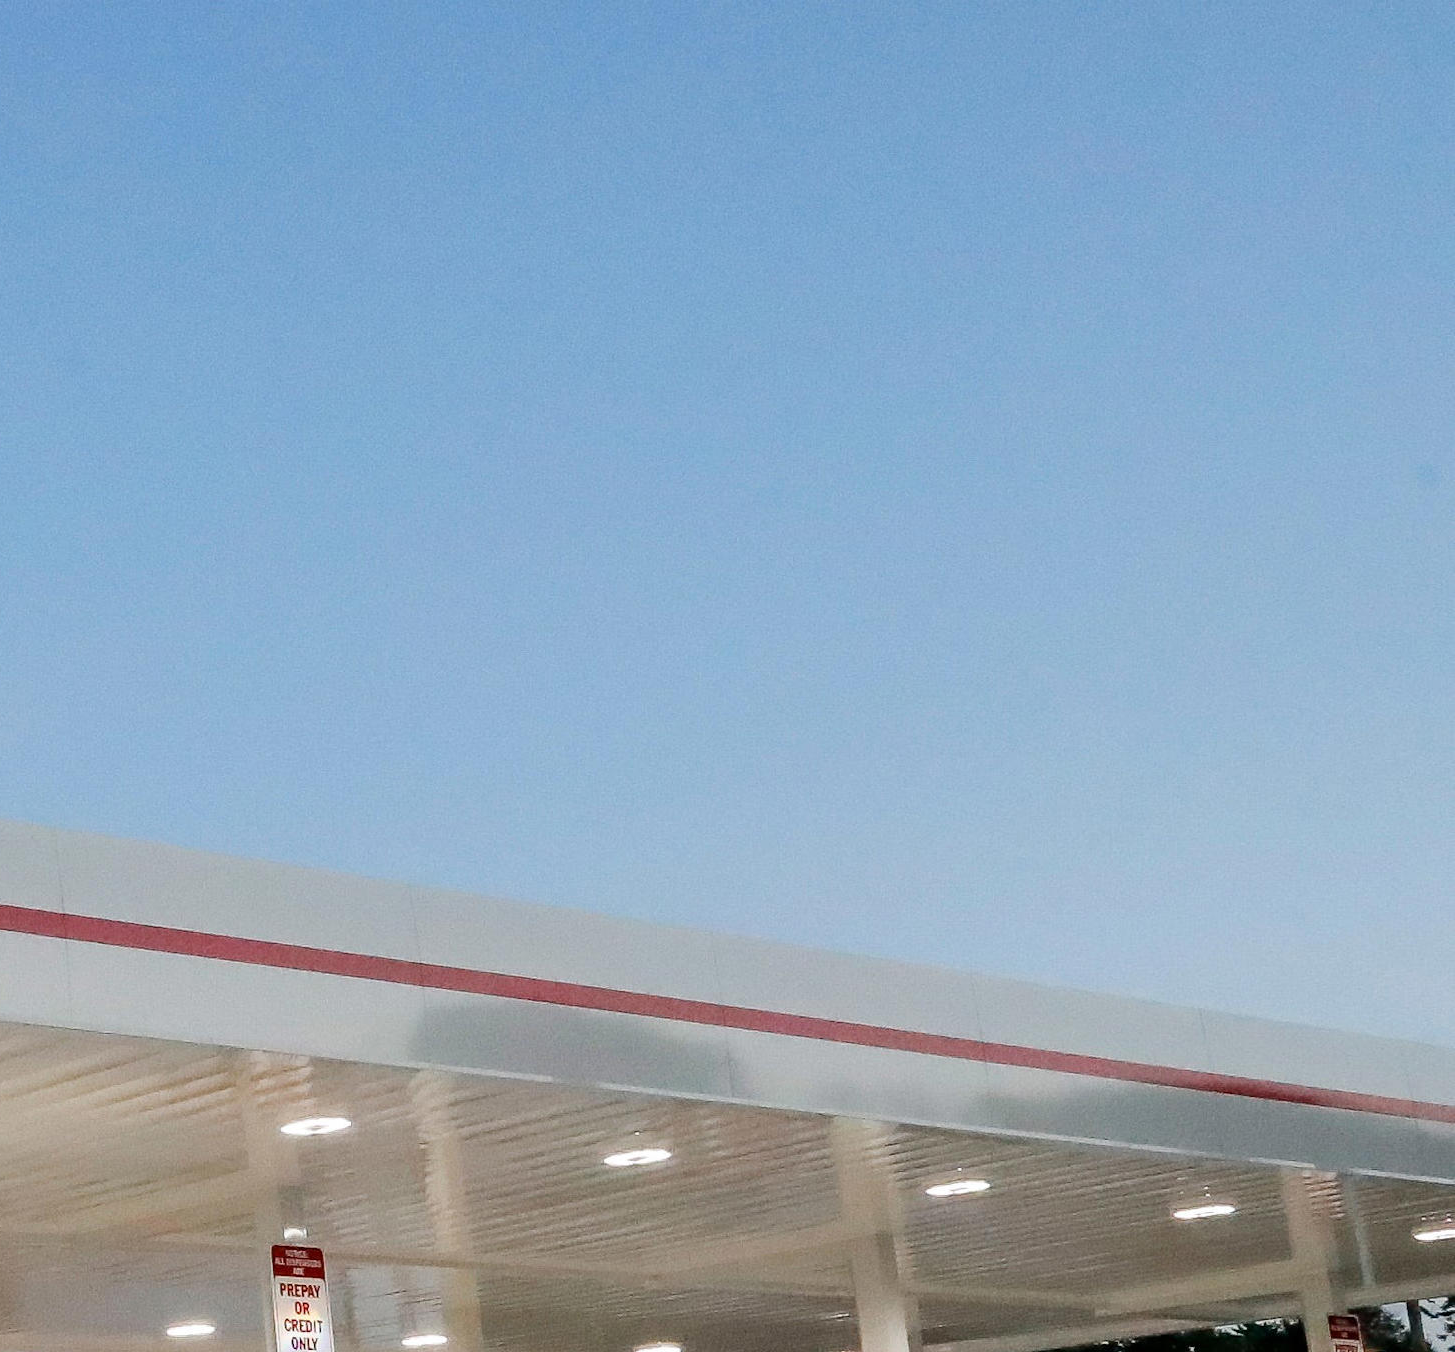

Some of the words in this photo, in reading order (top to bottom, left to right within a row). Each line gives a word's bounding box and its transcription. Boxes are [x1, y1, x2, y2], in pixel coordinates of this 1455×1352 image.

[279, 1282, 321, 1298] PREPAY
[294, 1301, 310, 1315] OR
[284, 1318, 323, 1334] CREDIT
[291, 1336, 319, 1351] ONLY
